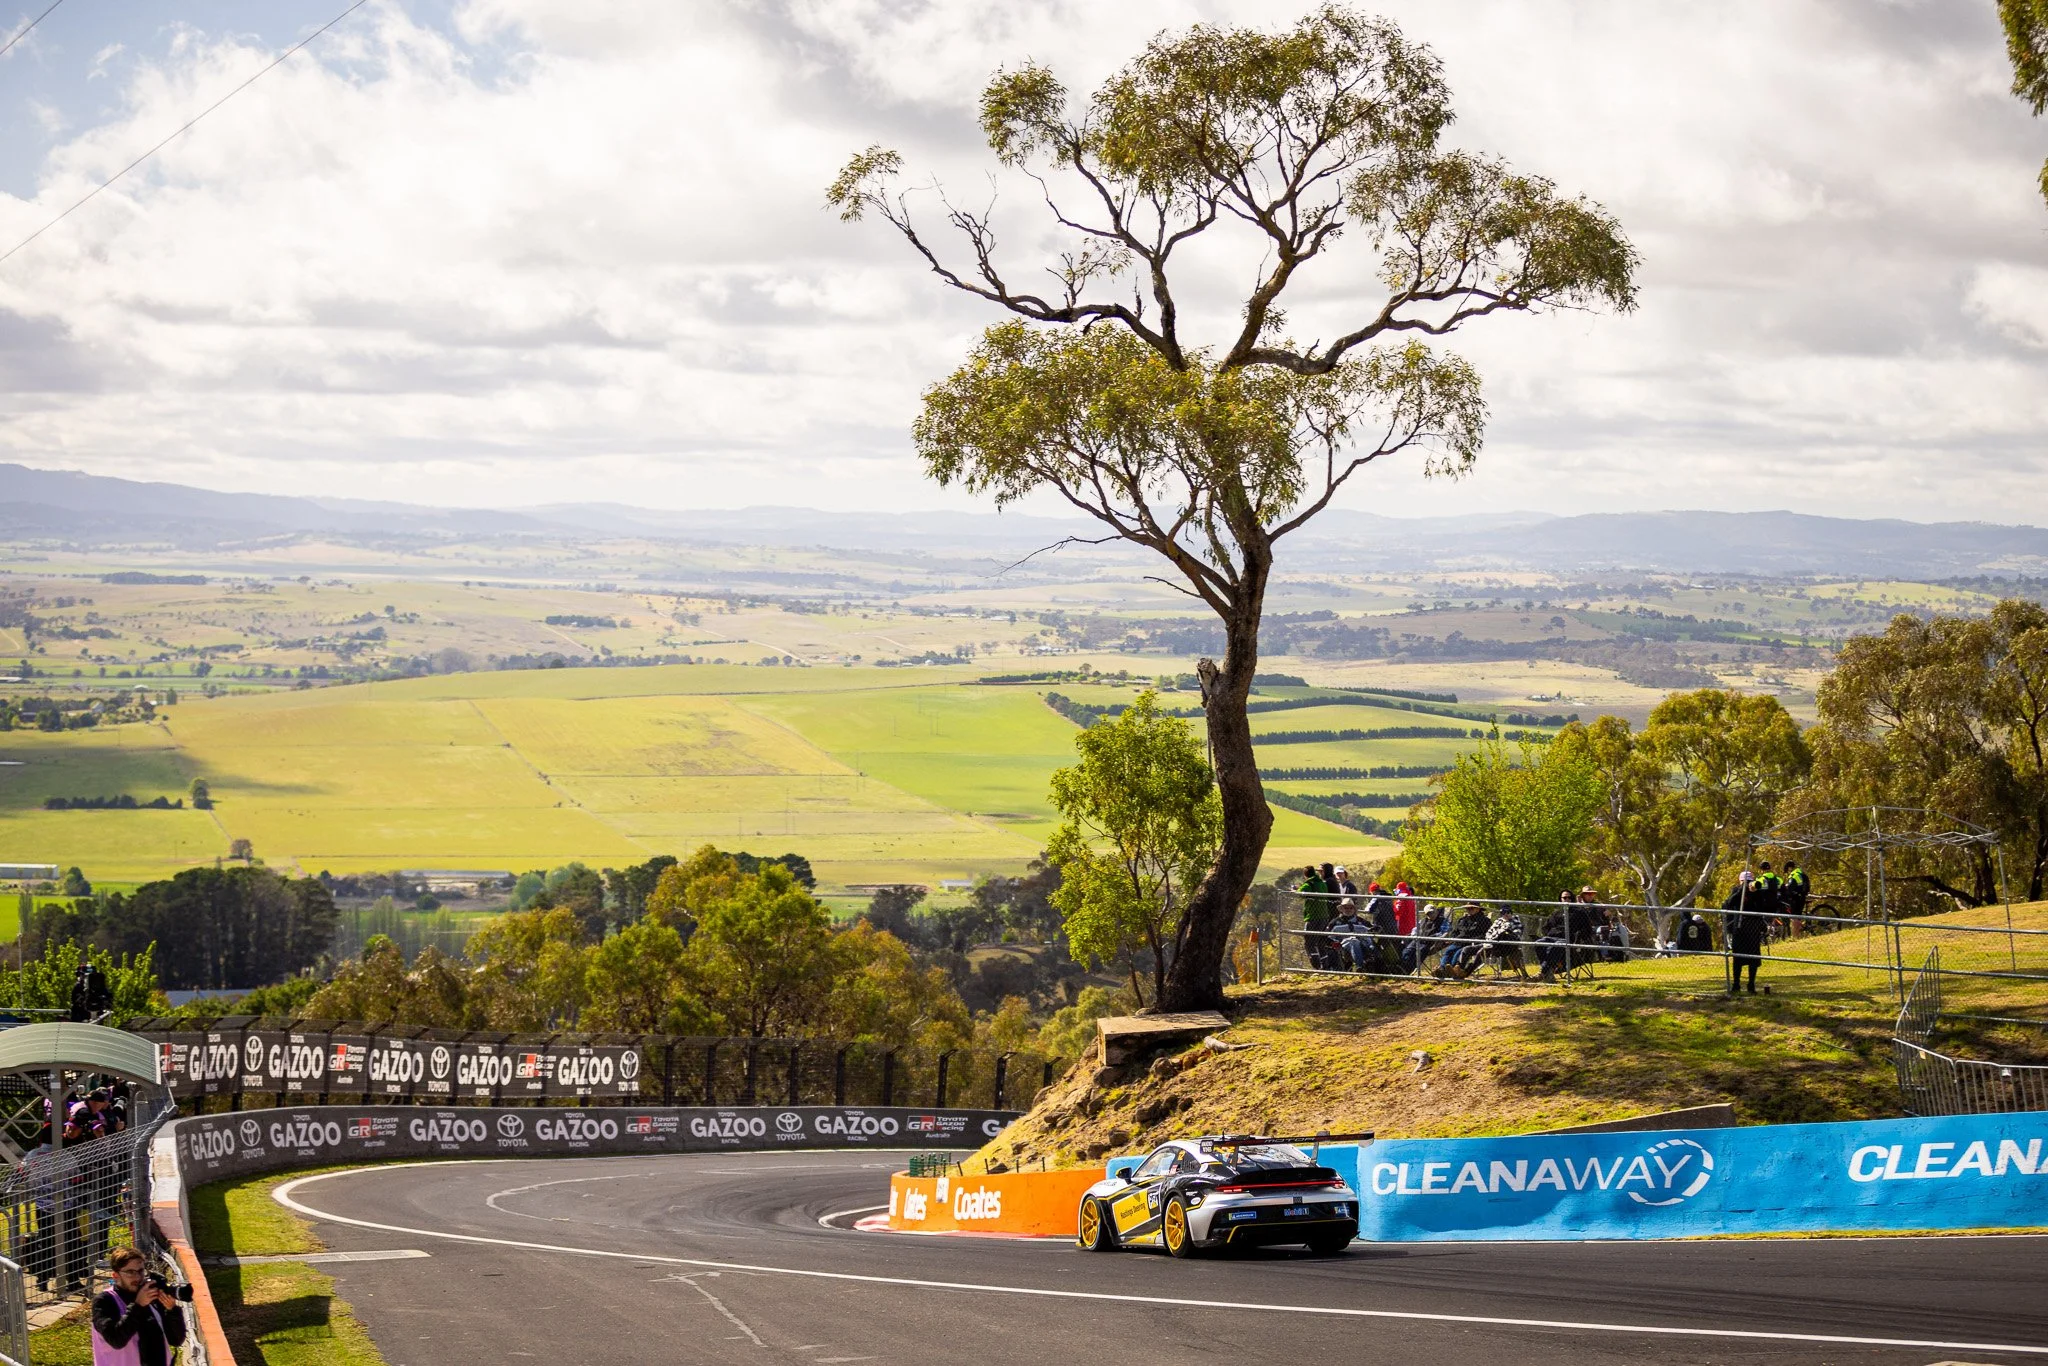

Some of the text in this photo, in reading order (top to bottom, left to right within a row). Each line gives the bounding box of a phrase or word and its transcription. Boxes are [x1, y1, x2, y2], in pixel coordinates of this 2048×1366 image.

[189, 1044, 238, 1081] GAZOO
[268, 1044, 324, 1079] GAZOO
[328, 1054, 346, 1070] GR
[368, 1048, 424, 1083] GAZOO
[456, 1054, 512, 1086] GAZOO
[516, 1063, 534, 1076] GR
[558, 1056, 614, 1086] GAZOO
[270, 1122, 342, 1148] GAZOO
[348, 1126, 370, 1136] GR
[410, 1118, 488, 1142] GAZOO
[536, 1119, 618, 1140] GAZOO
[626, 1123, 650, 1132] GR
[690, 1118, 766, 1138] GAZOO
[814, 1115, 899, 1136] GAZOO
[908, 1122, 934, 1130] GR
[190, 1128, 235, 1160] GAZOO
[242, 1148, 266, 1159] TOYOTA
[497, 1139, 528, 1147] TOYOTA
[1372, 1154, 1692, 1195] CLEANAWAY
[954, 1186, 1001, 1220] Coates
